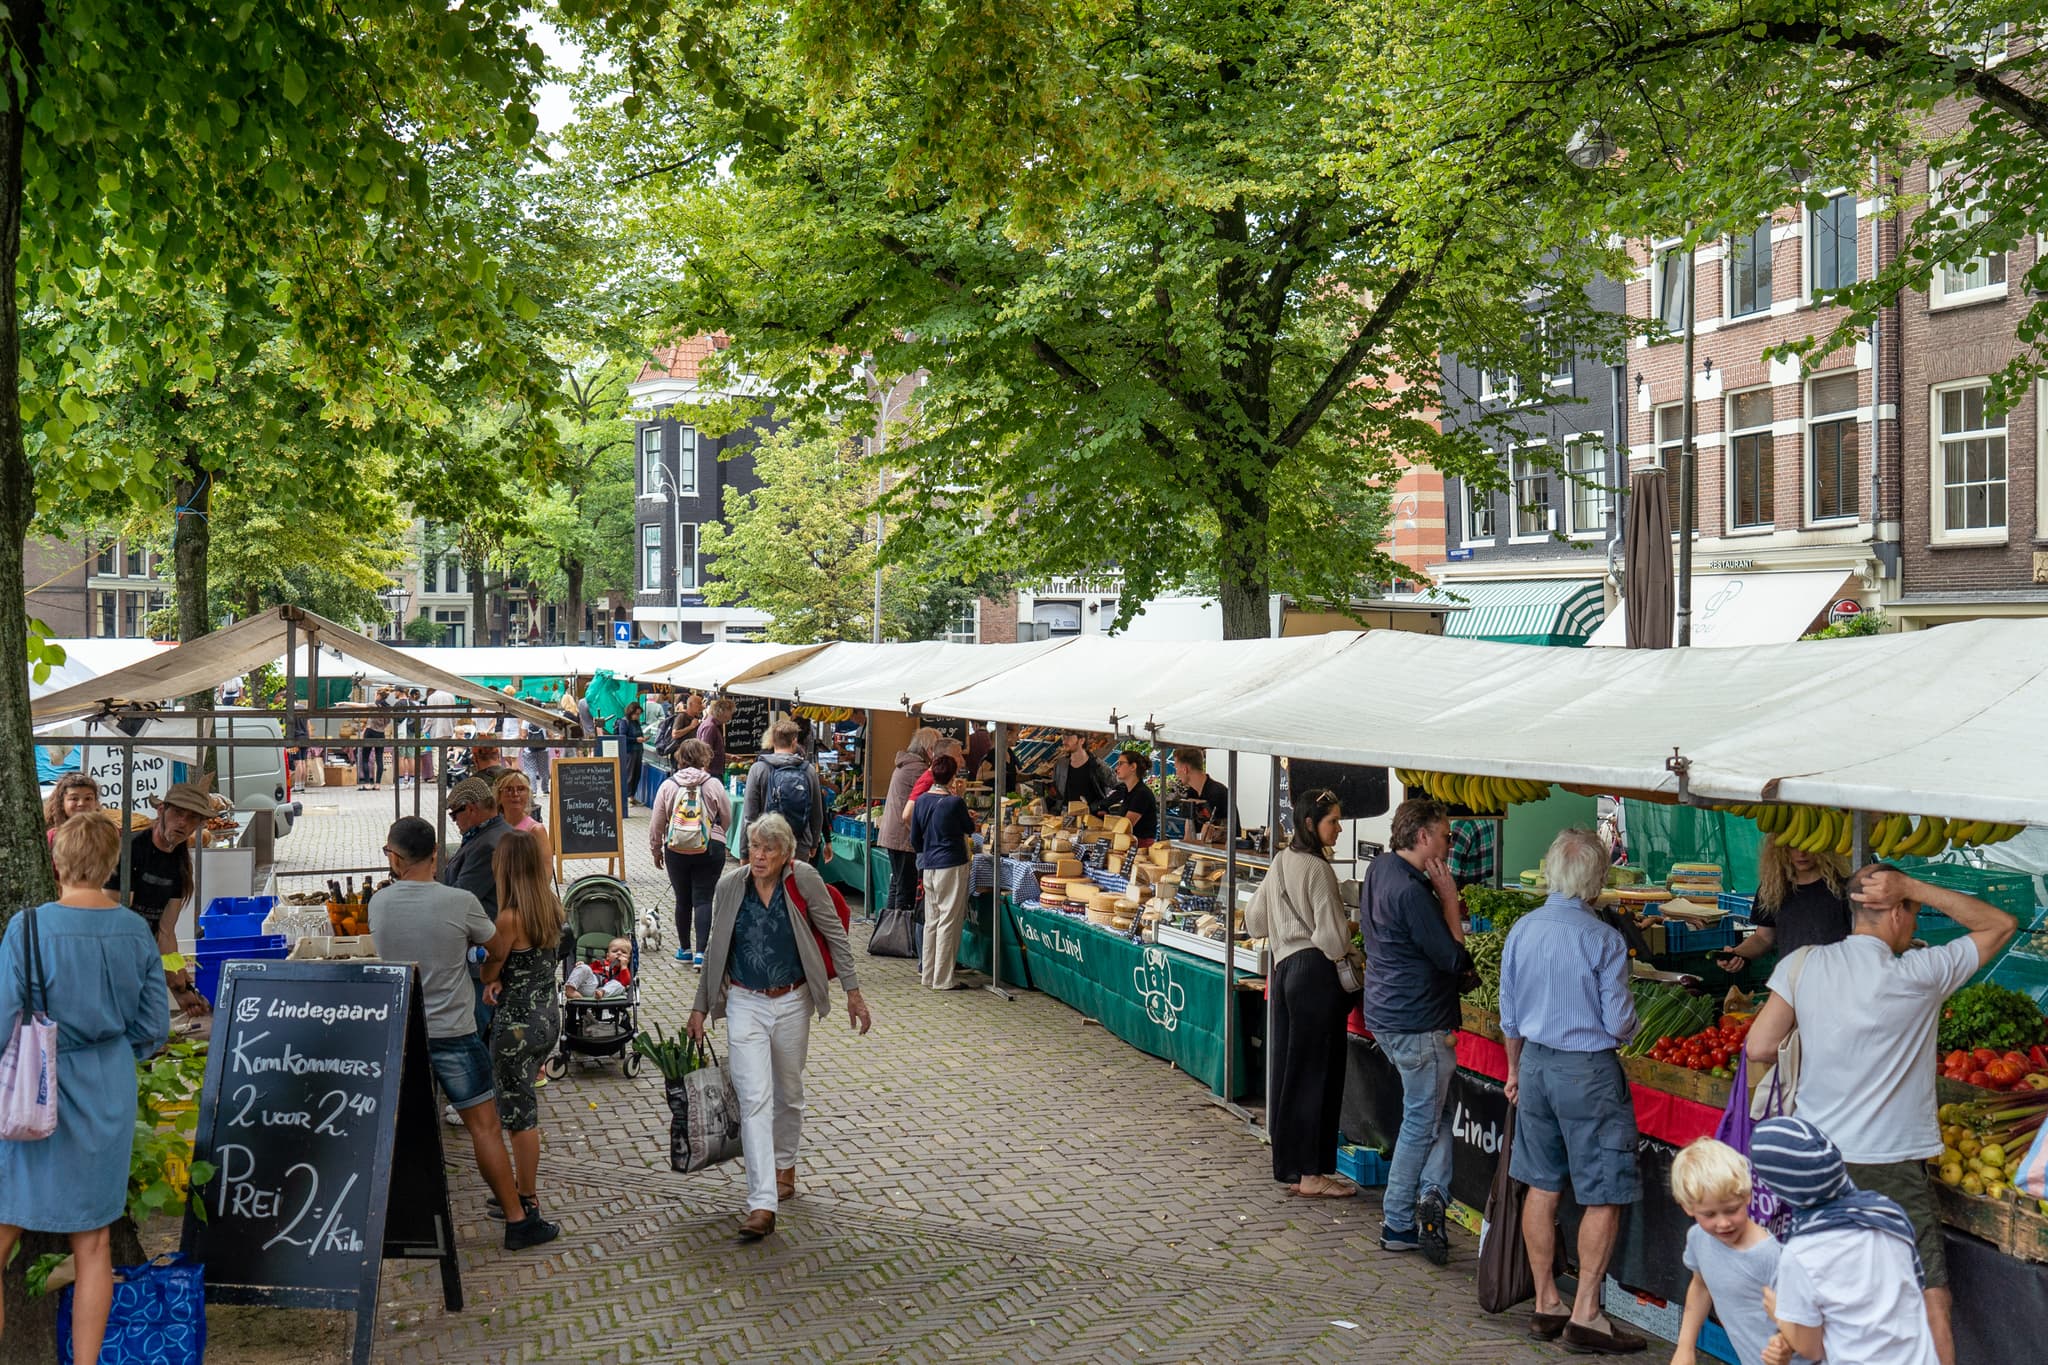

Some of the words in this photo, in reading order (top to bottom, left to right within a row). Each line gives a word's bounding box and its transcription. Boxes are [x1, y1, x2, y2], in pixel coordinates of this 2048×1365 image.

[1709, 559, 1754, 569] RESTAURANT
[91, 757, 164, 777] AFSAND
[136, 777, 158, 792] BIJ
[266, 998, 389, 1026] Lindegaard
[227, 1084, 257, 1128] 2
